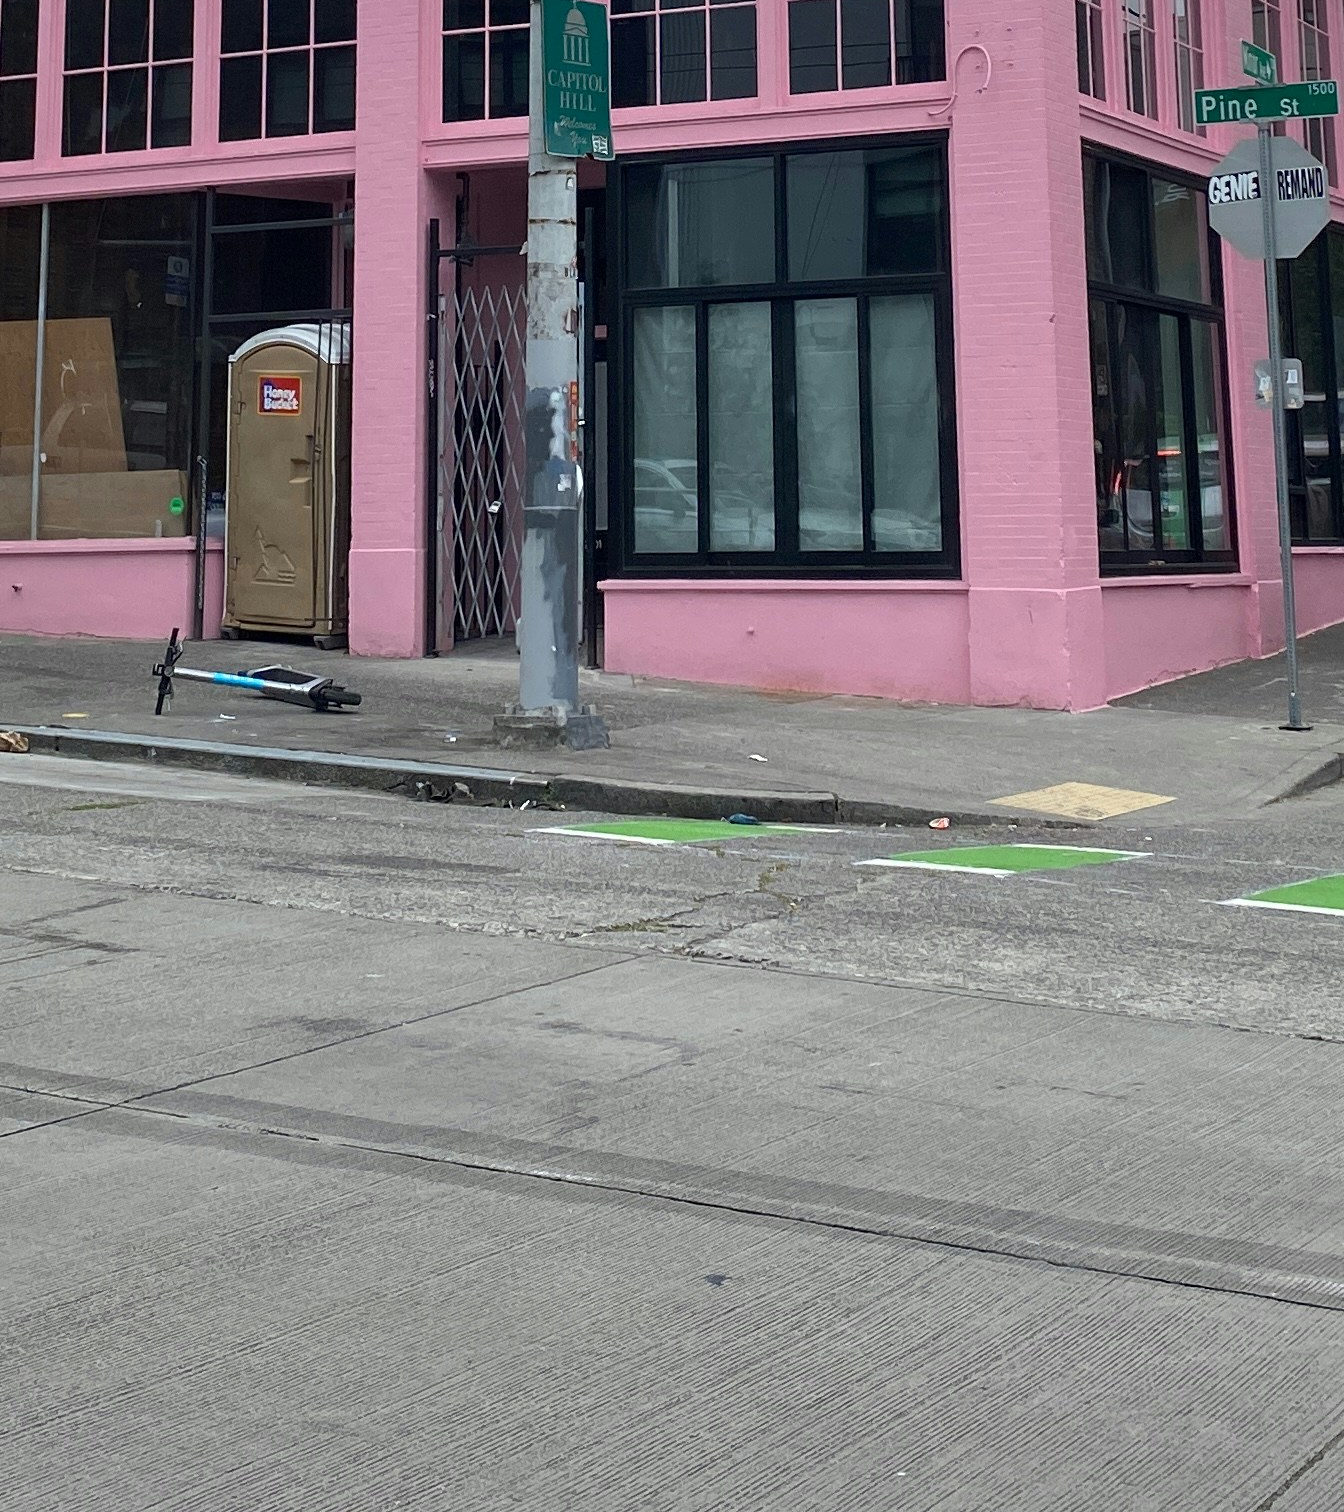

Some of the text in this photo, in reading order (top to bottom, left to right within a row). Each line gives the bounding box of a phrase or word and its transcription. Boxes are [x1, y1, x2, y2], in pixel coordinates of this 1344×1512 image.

[547, 69, 607, 93] CAPITOL
[1307, 82, 1335, 95] 1500
[559, 90, 596, 112] HILL
[1201, 95, 1300, 122] Pine St
[1208, 171, 1259, 204] GENIE
[1276, 167, 1325, 201] REMAND
[263, 384, 296, 401] Honey
[263, 397, 299, 410] Bucket
